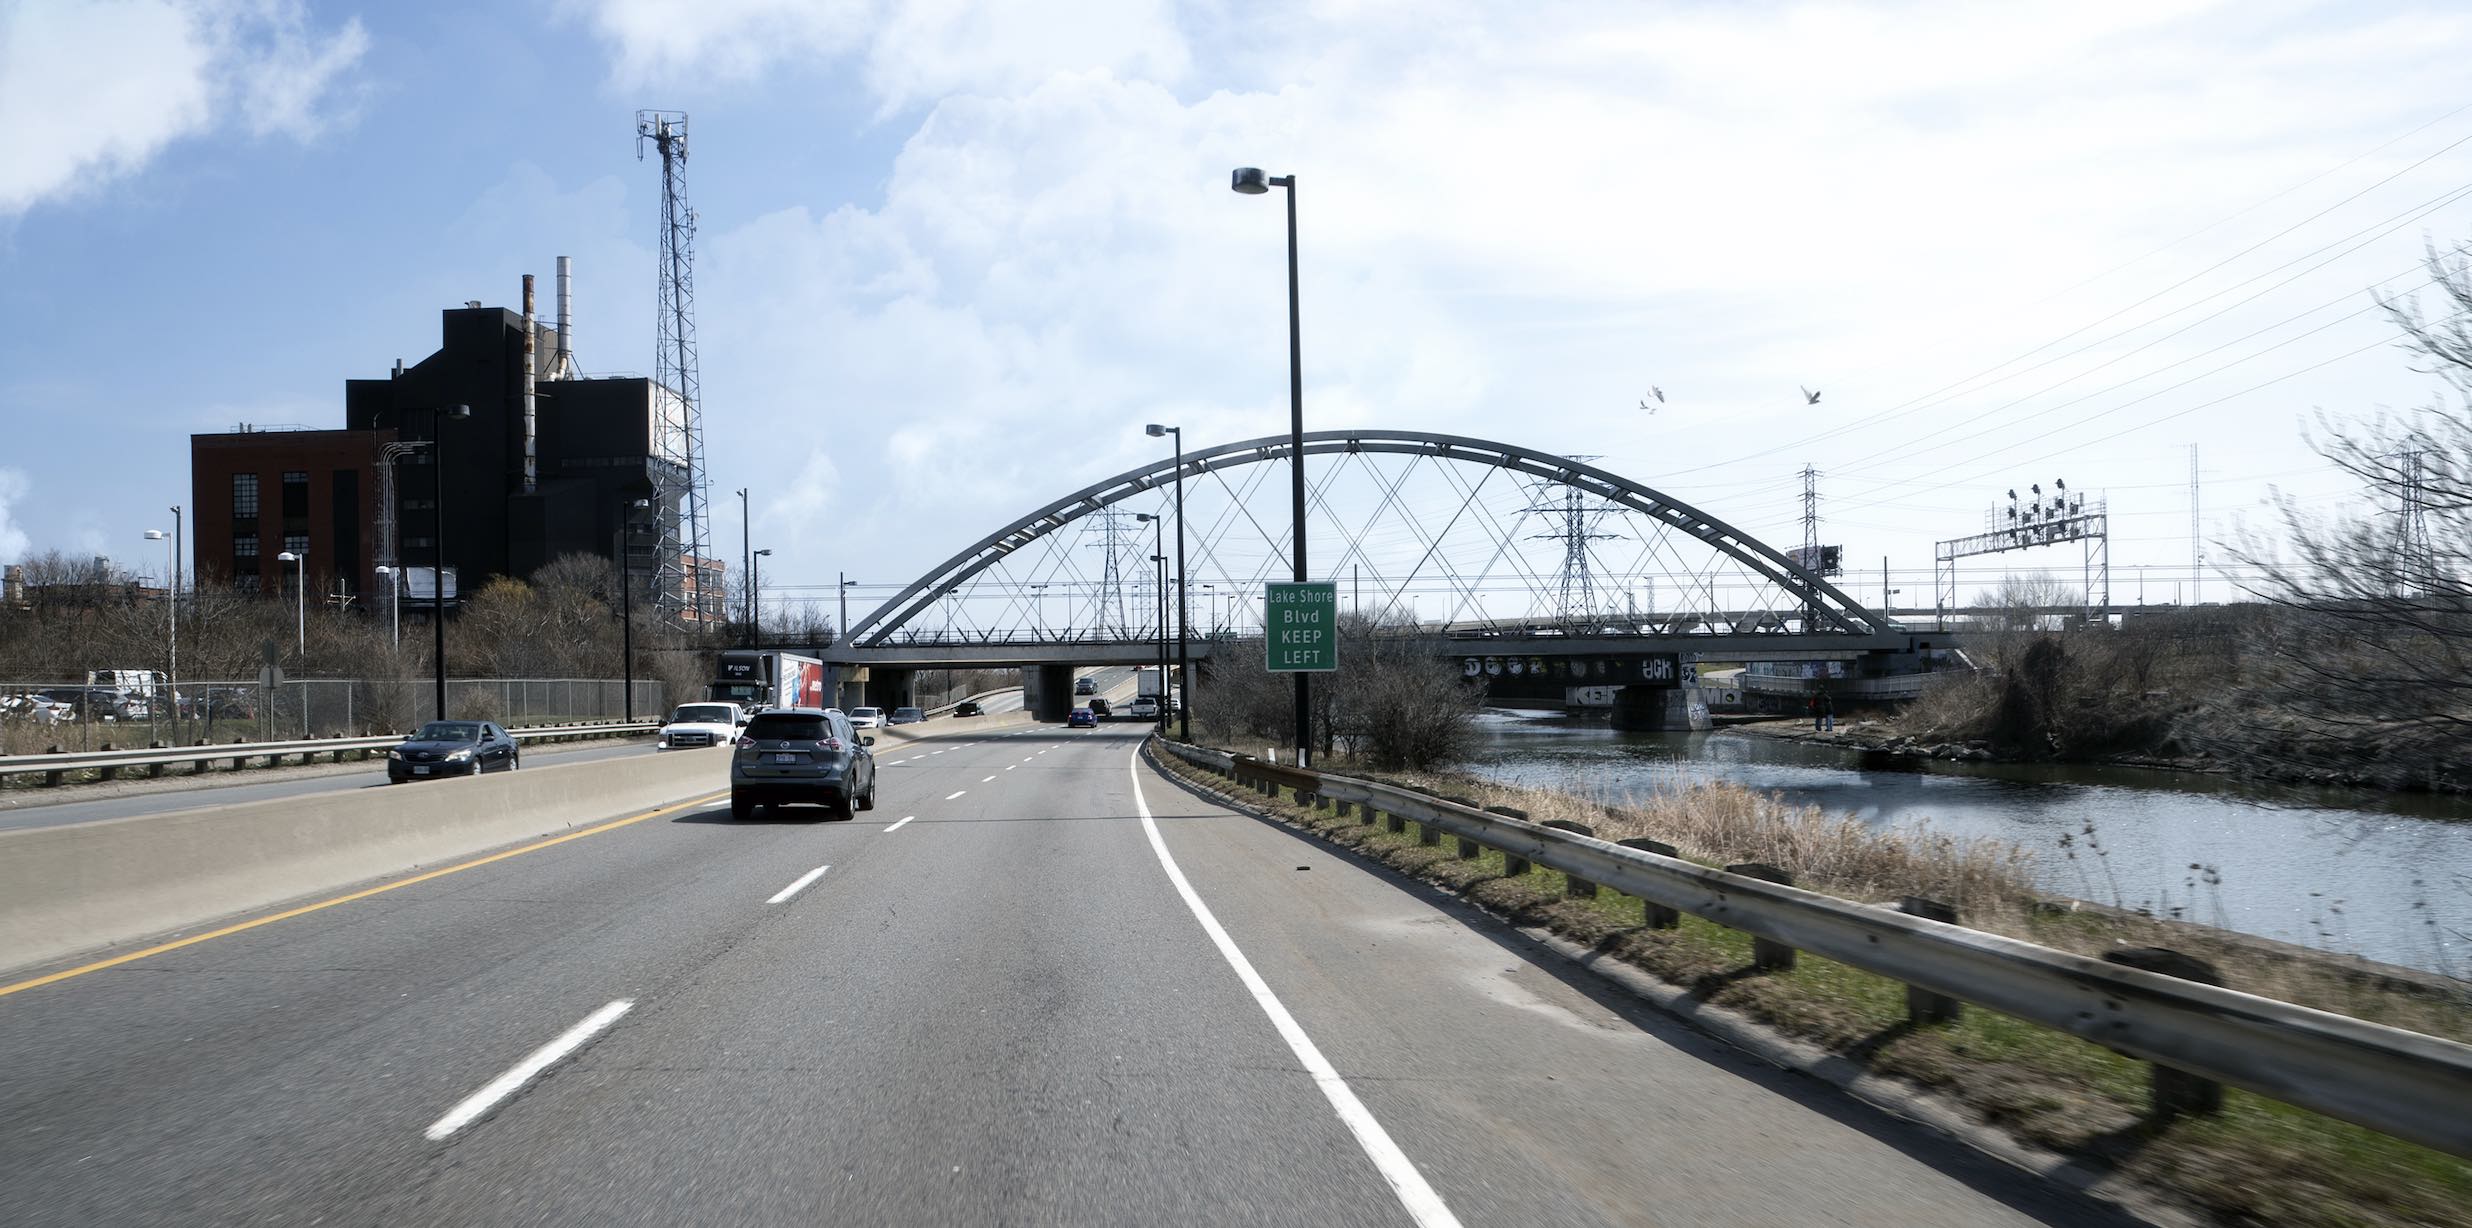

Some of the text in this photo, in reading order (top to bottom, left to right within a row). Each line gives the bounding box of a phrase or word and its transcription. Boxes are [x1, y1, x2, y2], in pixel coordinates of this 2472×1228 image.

[1269, 589, 1333, 604] Lake Shore
[1284, 609, 1319, 624] Blvd
[1281, 630, 1322, 644] KEEP
[1284, 650, 1320, 664] LEFT
